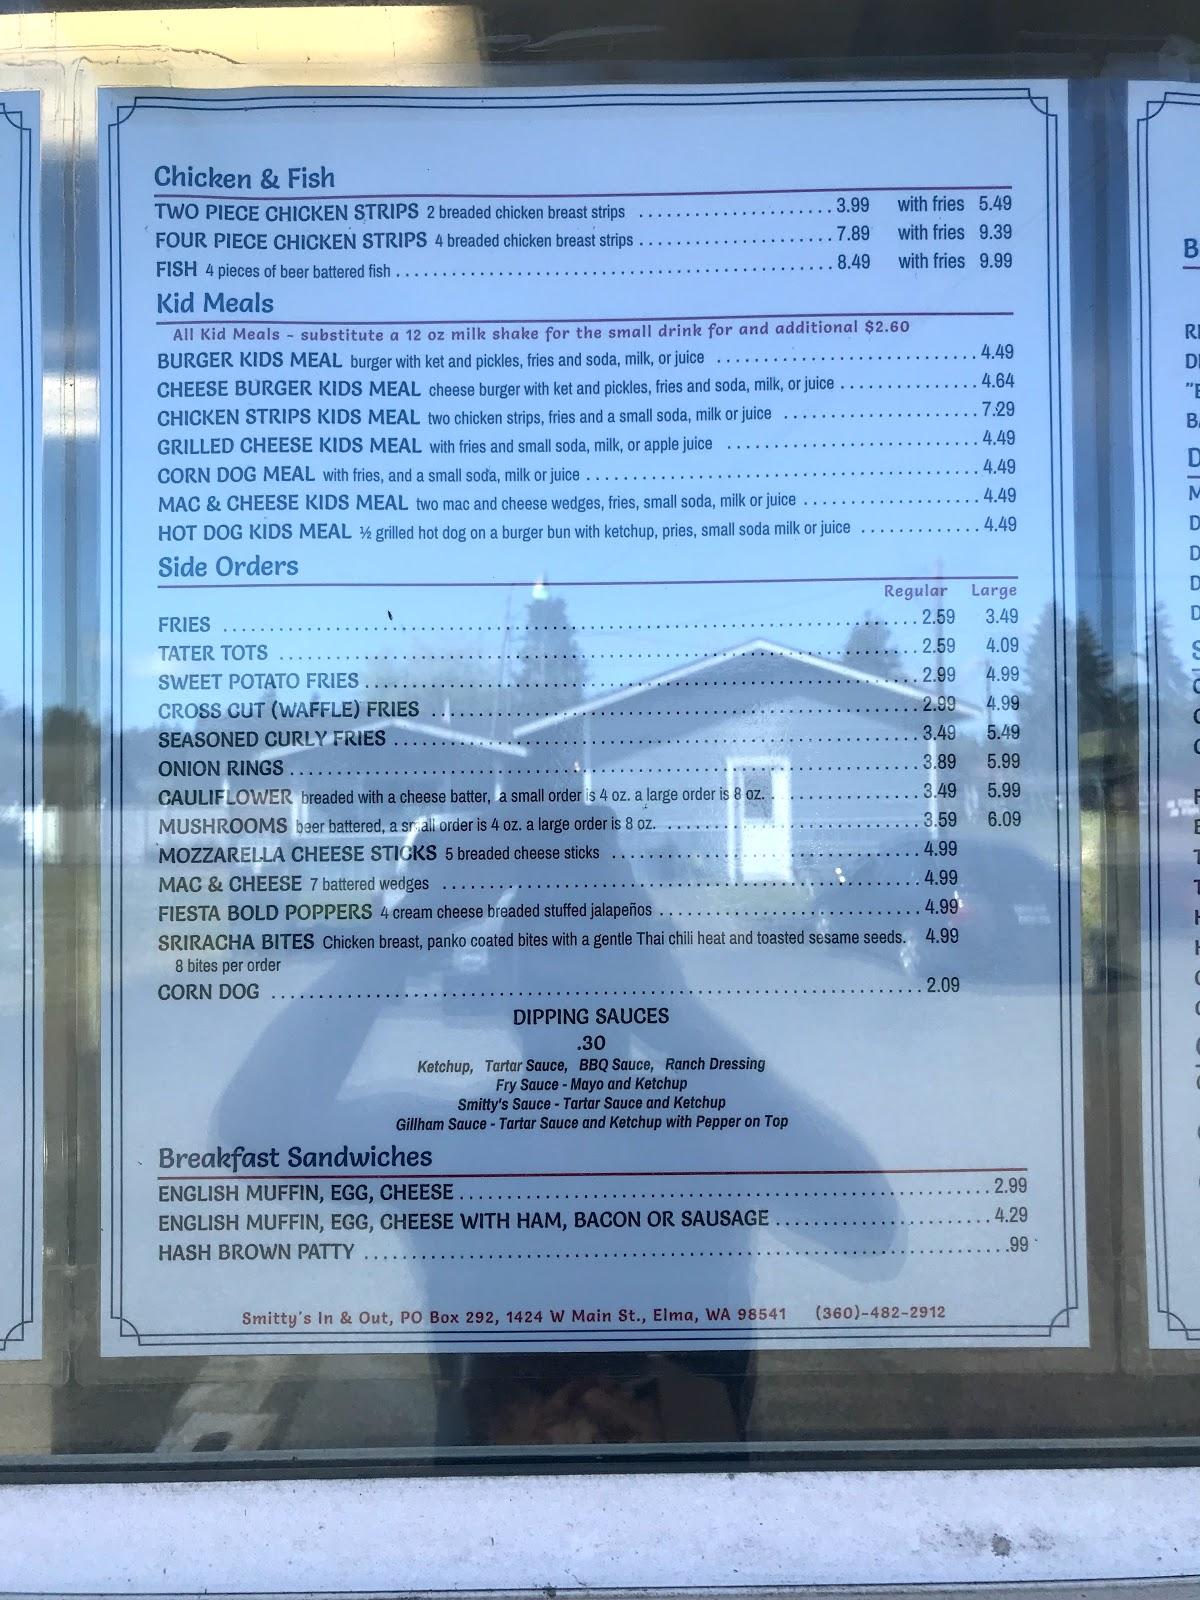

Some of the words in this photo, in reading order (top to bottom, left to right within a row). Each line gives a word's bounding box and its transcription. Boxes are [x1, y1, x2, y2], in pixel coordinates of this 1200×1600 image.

[154, 165, 251, 189] Chicken
[260, 168, 280, 190] &
[288, 165, 335, 189] Fish
[154, 203, 199, 220] TWO
[206, 204, 259, 222] PIECE
[265, 204, 348, 222] CHICKEN
[354, 202, 419, 221] STRIPS
[427, 205, 435, 219] 2
[439, 204, 491, 220] breaded
[495, 205, 543, 220] chicken
[548, 205, 588, 219] breast
[591, 204, 625, 221] strips
[836, 197, 870, 213] 3.99
[897, 195, 928, 212] with
[932, 195, 965, 212] fries
[979, 195, 1012, 211] 5.49
[156, 260, 197, 277] FISH
[205, 263, 214, 277] 4
[218, 263, 260, 280] pieces
[264, 264, 277, 278] of
[280, 264, 309, 279] beer
[313, 264, 365, 279] battered
[368, 263, 391, 278] fish
[838, 253, 870, 270] 8.49
[898, 252, 928, 269] with
[933, 252, 965, 269] fries
[980, 252, 1013, 269] 9.99
[157, 291, 194, 314] Kid
[203, 292, 274, 313] Meals
[173, 327, 193, 341] All
[201, 327, 226, 341] Kid
[233, 327, 280, 341] Meals
[301, 328, 383, 342] substitute
[390, 331, 399, 341] a
[406, 329, 421, 341] 12
[427, 331, 445, 341] oz
[451, 327, 486, 341] milk
[492, 326, 538, 341] shake
[545, 326, 570, 342] for
[576, 325, 602, 339] the
[608, 324, 651, 339] small
[658, 323, 702, 337] drink
[708, 322, 733, 339] for
[739, 321, 768, 335] and
[775, 319, 858, 335] additional
[865, 319, 910, 335] $2.60
[158, 351, 234, 369] BURGER
[240, 351, 283, 368] KIDS
[290, 352, 343, 368] MEAL
[351, 354, 392, 372] burger
[395, 354, 421, 369] with
[425, 354, 444, 369] ket
[448, 353, 472, 368] and
[476, 353, 523, 371] pickles,
[527, 353, 554, 367] fries
[558, 352, 582, 367] and
[586, 352, 620, 368] soda,
[625, 351, 654, 367] milk,
[658, 353, 671, 365] or
[674, 350, 704, 368] juice
[981, 343, 1014, 359] 4.49
[158, 467, 210, 484] CORN
[217, 466, 256, 483] DOG
[263, 465, 316, 482] MEAL
[323, 468, 349, 482] with
[353, 467, 384, 484] fries,
[388, 468, 412, 482] and
[416, 471, 425, 483] a
[428, 468, 462, 482] small
[466, 468, 500, 484] soda,
[505, 467, 531, 482] milk
[534, 470, 547, 482] or
[549, 467, 580, 485] juice
[983, 458, 1016, 474] 4.49
[158, 555, 207, 578] Side
[216, 554, 299, 577] Orders
[884, 583, 948, 601] Regular
[972, 584, 1017, 600] Large
[159, 616, 211, 633] FRIES
[922, 608, 955, 625] 2.59
[986, 608, 1018, 624] 3.49
[158, 673, 223, 690] SWEET
[229, 673, 300, 690] POTATO
[306, 672, 359, 689] FRIES
[923, 666, 956, 683] 2.99
[986, 666, 1020, 682] 4.99
[158, 702, 221, 720] CROSS
[227, 702, 266, 719] CUT
[271, 699, 360, 720] (WAFFLE)
[367, 701, 419, 718] FRIES
[923, 695, 956, 712] 2.99
[986, 695, 1020, 711] 4.99
[159, 876, 202, 893] MAC
[208, 876, 223, 892] &
[229, 875, 302, 892] CHEESE
[310, 877, 318, 891] 7
[322, 876, 375, 891] battered
[379, 876, 429, 893] wedges
[924, 869, 958, 886] 4.99
[159, 905, 221, 922] FIESTA
[228, 904, 279, 921] BOLD
[285, 903, 373, 921] POPPERS
[380, 906, 389, 919] 4
[392, 907, 433, 920] cream
[437, 904, 483, 919] cheese
[488, 903, 540, 918] breaded
[544, 902, 587, 918] stuffed
[590, 901, 652, 920] jalapeños
[925, 898, 959, 914] 4.99
[175, 959, 183, 973] 8
[187, 958, 218, 973] bites
[222, 961, 244, 975] per
[247, 957, 281, 972] order
[513, 1008, 589, 1025] DIPPING
[595, 1007, 669, 1024] SAUCES
[577, 1035, 606, 1051] .30
[418, 1059, 473, 1076] Ketchup,
[485, 1059, 523, 1072] Tartar
[525, 1058, 568, 1074] Sauce,
[579, 1058, 609, 1073] BBQ
[612, 1057, 654, 1073] Sauce,
[665, 1056, 705, 1071] Ranch
[709, 1056, 766, 1073] Dressing
[159, 1145, 280, 1173] Breakfast
[288, 1144, 432, 1168] Sandwiches
[159, 1185, 239, 1202] ENGLISH
[246, 1184, 324, 1204] MUFFIN,
[331, 1184, 374, 1204] EGG,
[380, 1183, 454, 1201] CHEESE
[994, 1177, 1027, 1194] 2.99
[159, 1244, 211, 1261] HASH
[218, 1243, 291, 1261] BROWN
[298, 1243, 355, 1260] PATTY
[242, 1311, 311, 1329] Smitty's
[318, 1311, 333, 1325] In
[340, 1311, 352, 1325] &
[359, 1311, 393, 1327] Out,
[401, 1311, 422, 1324] PO
[430, 1310, 459, 1324] Box
[466, 1311, 499, 1326] 292,
[506, 1310, 543, 1324] 1424
[549, 1309, 565, 1323] W
[572, 1308, 611, 1323] Main
[618, 1308, 646, 1325] St.,
[653, 1307, 698, 1324] Elma,
[705, 1307, 731, 1321] WA
[738, 1307, 785, 1321] 98541
[816, 1304, 945, 1321] (360)-482-2912
